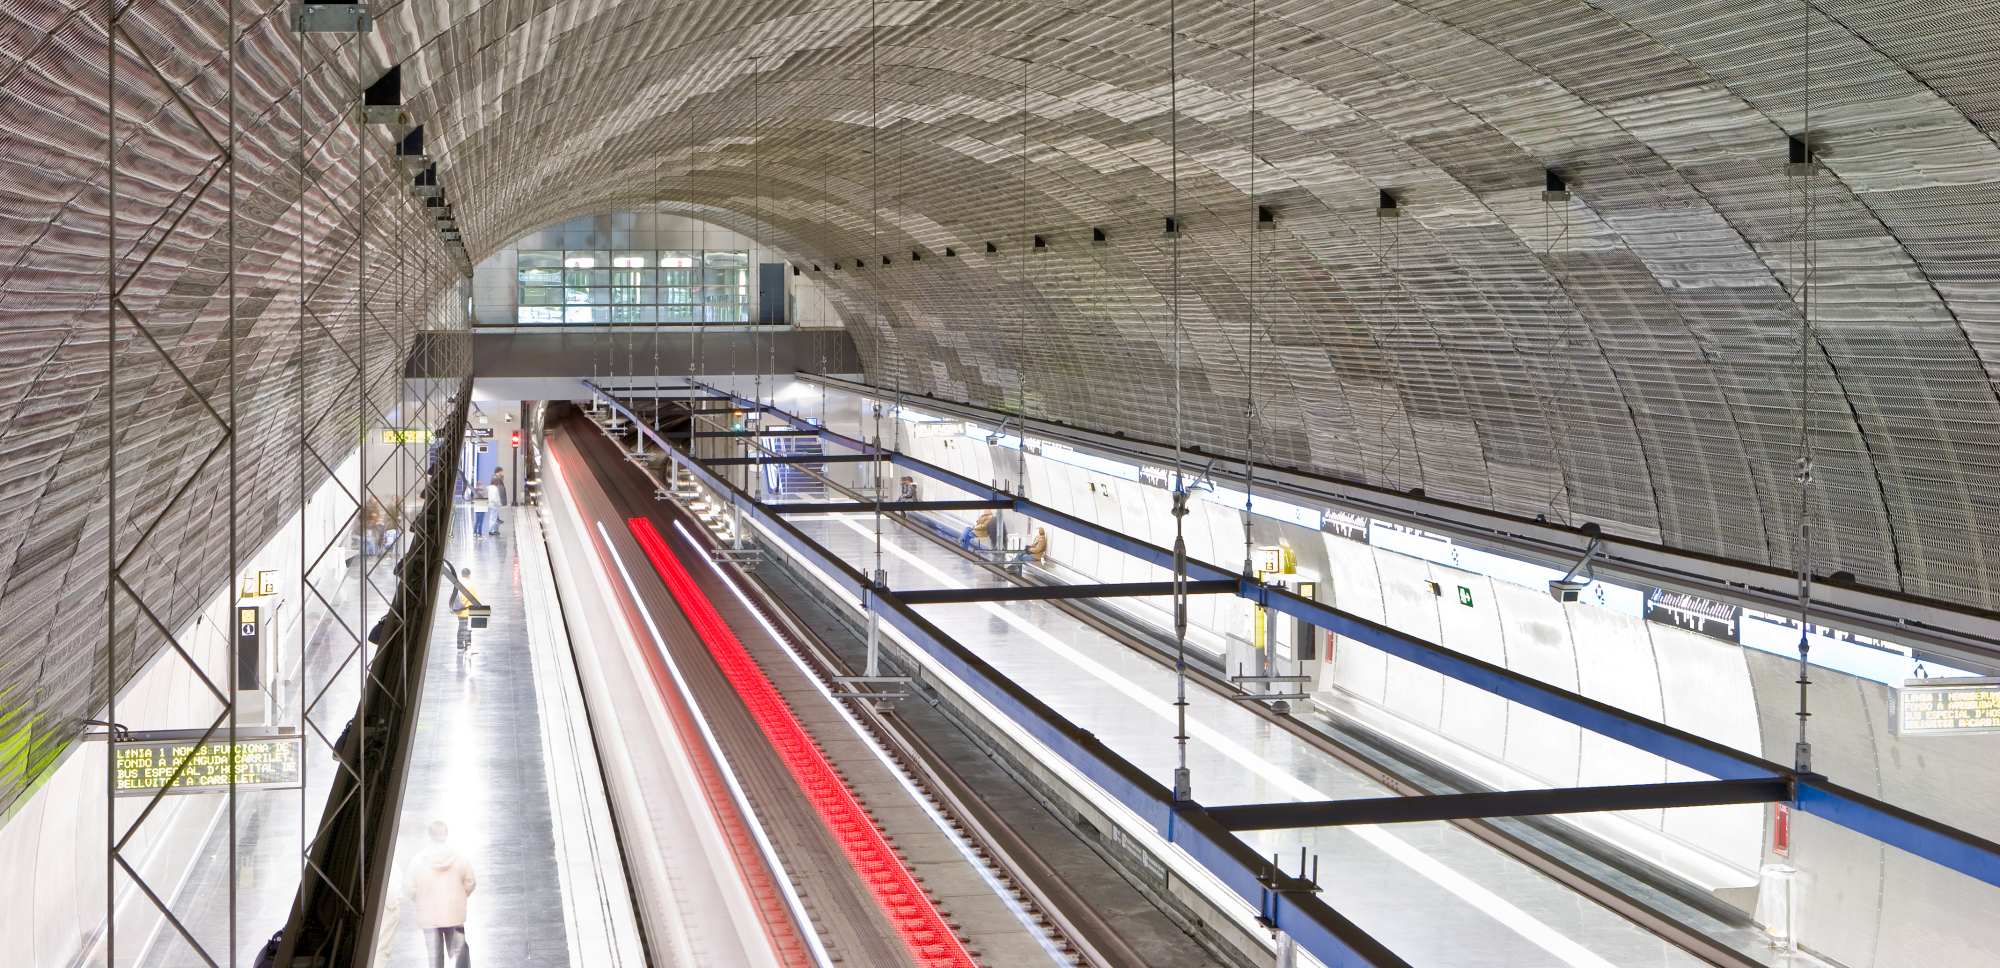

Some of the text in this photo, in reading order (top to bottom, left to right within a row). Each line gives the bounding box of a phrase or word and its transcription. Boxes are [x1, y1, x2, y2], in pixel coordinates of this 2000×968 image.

[159, 747, 165, 758] 1
[116, 758, 152, 769] FONDO
[158, 757, 166, 767] A
[117, 768, 138, 779] BUS
[186, 776, 194, 786] A
